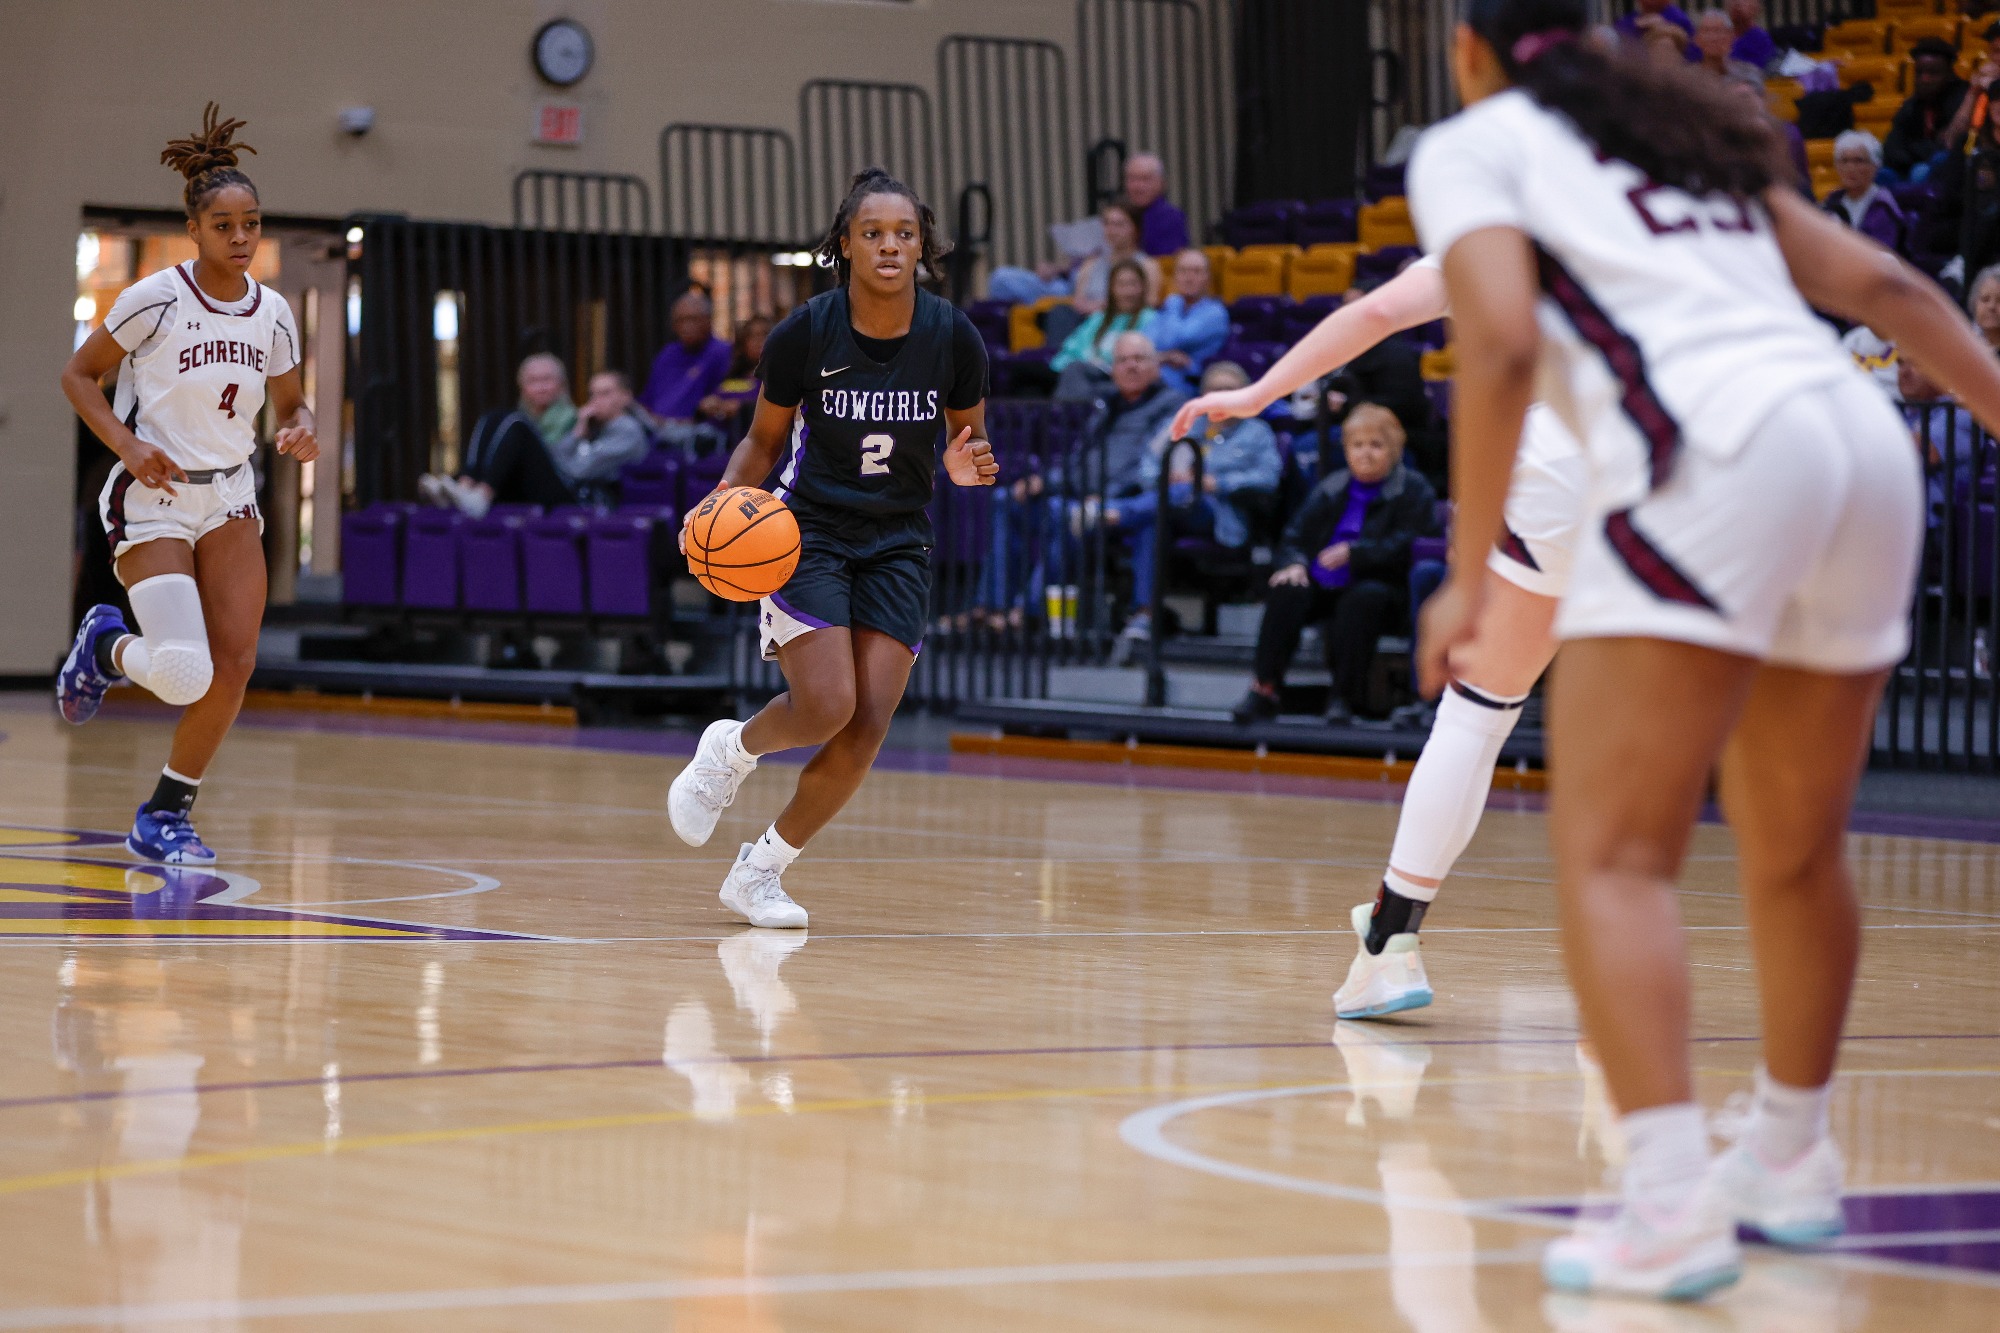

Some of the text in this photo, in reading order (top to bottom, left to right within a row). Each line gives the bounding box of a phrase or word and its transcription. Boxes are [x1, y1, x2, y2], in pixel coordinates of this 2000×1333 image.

[178, 340, 268, 374] SCHREINE
[218, 383, 239, 419] 4
[821, 389, 938, 421] COWGIRLS
[860, 433, 895, 476] 2
